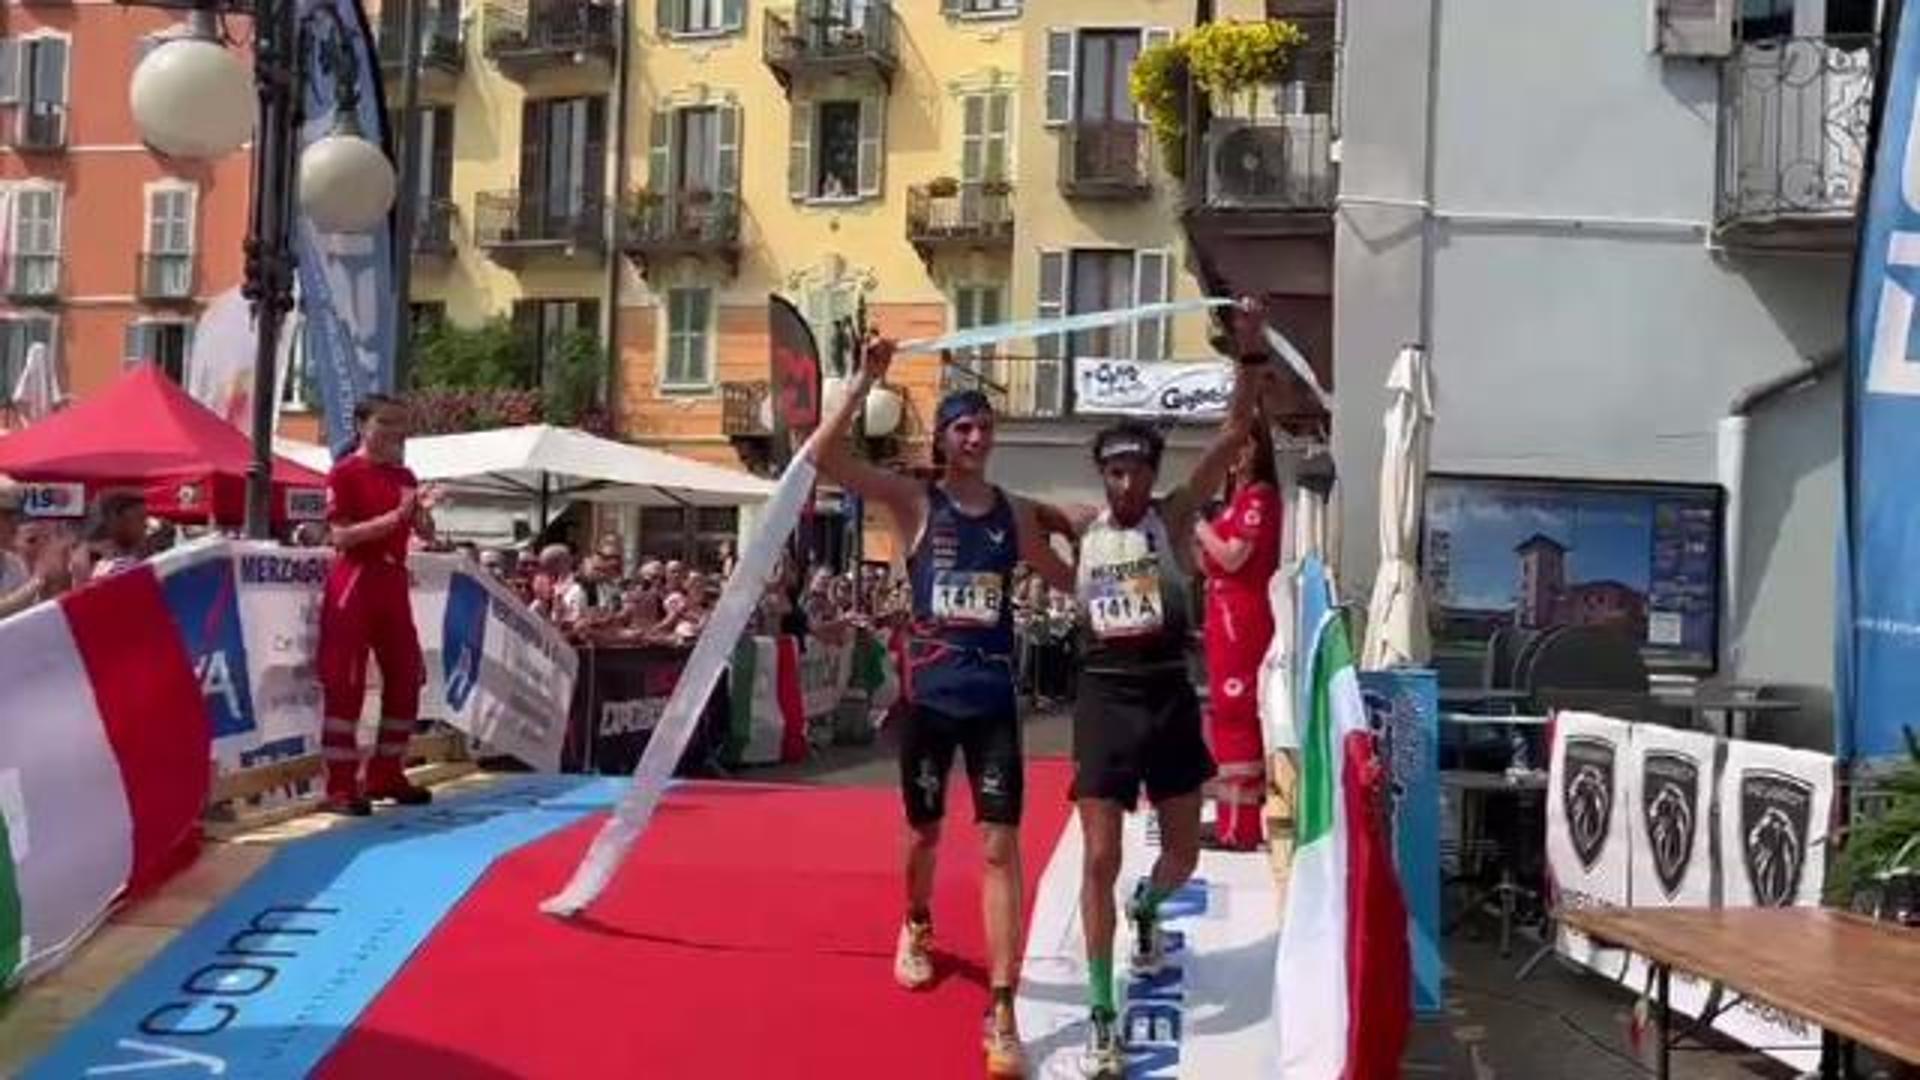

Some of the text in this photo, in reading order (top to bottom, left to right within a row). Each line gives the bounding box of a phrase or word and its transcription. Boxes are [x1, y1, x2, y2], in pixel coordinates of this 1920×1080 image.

[941, 588, 976, 609] 141
[1097, 593, 1156, 618] 141 A
